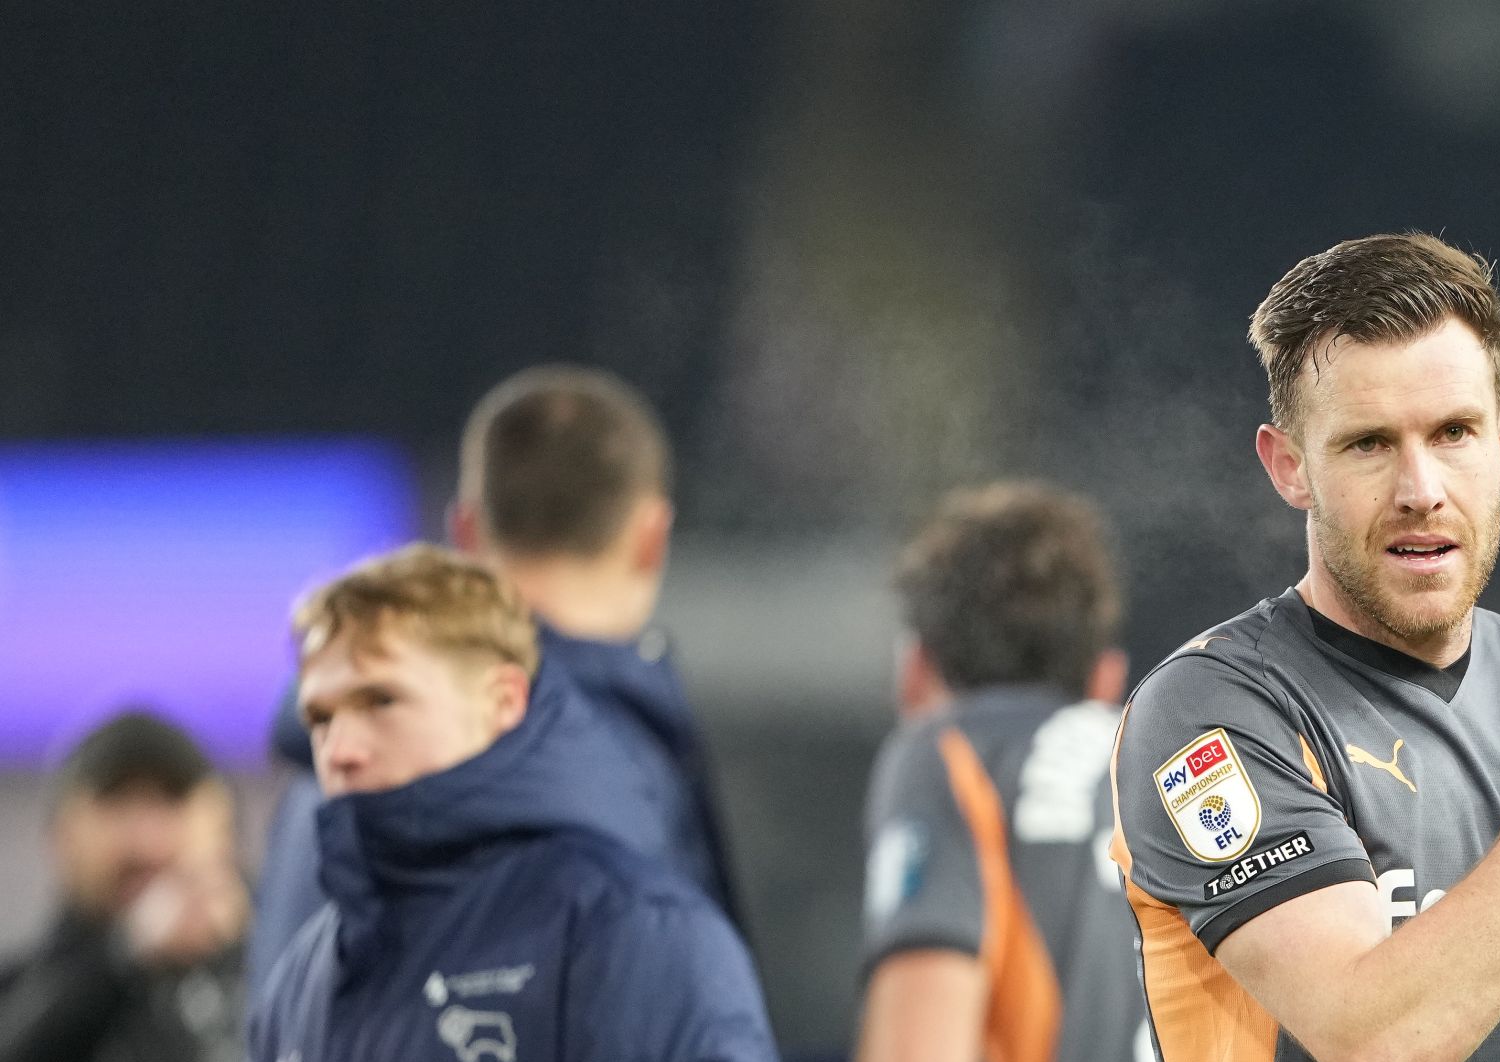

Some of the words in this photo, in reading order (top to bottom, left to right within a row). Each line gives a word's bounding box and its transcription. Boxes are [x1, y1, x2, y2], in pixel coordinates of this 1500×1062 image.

[1163, 765, 1187, 793] sky
[1190, 743, 1222, 771] bet
[1171, 763, 1233, 809] CHAMPIONSHIP
[1214, 827, 1242, 850] EFL
[1207, 836, 1311, 896] TOGETHER
